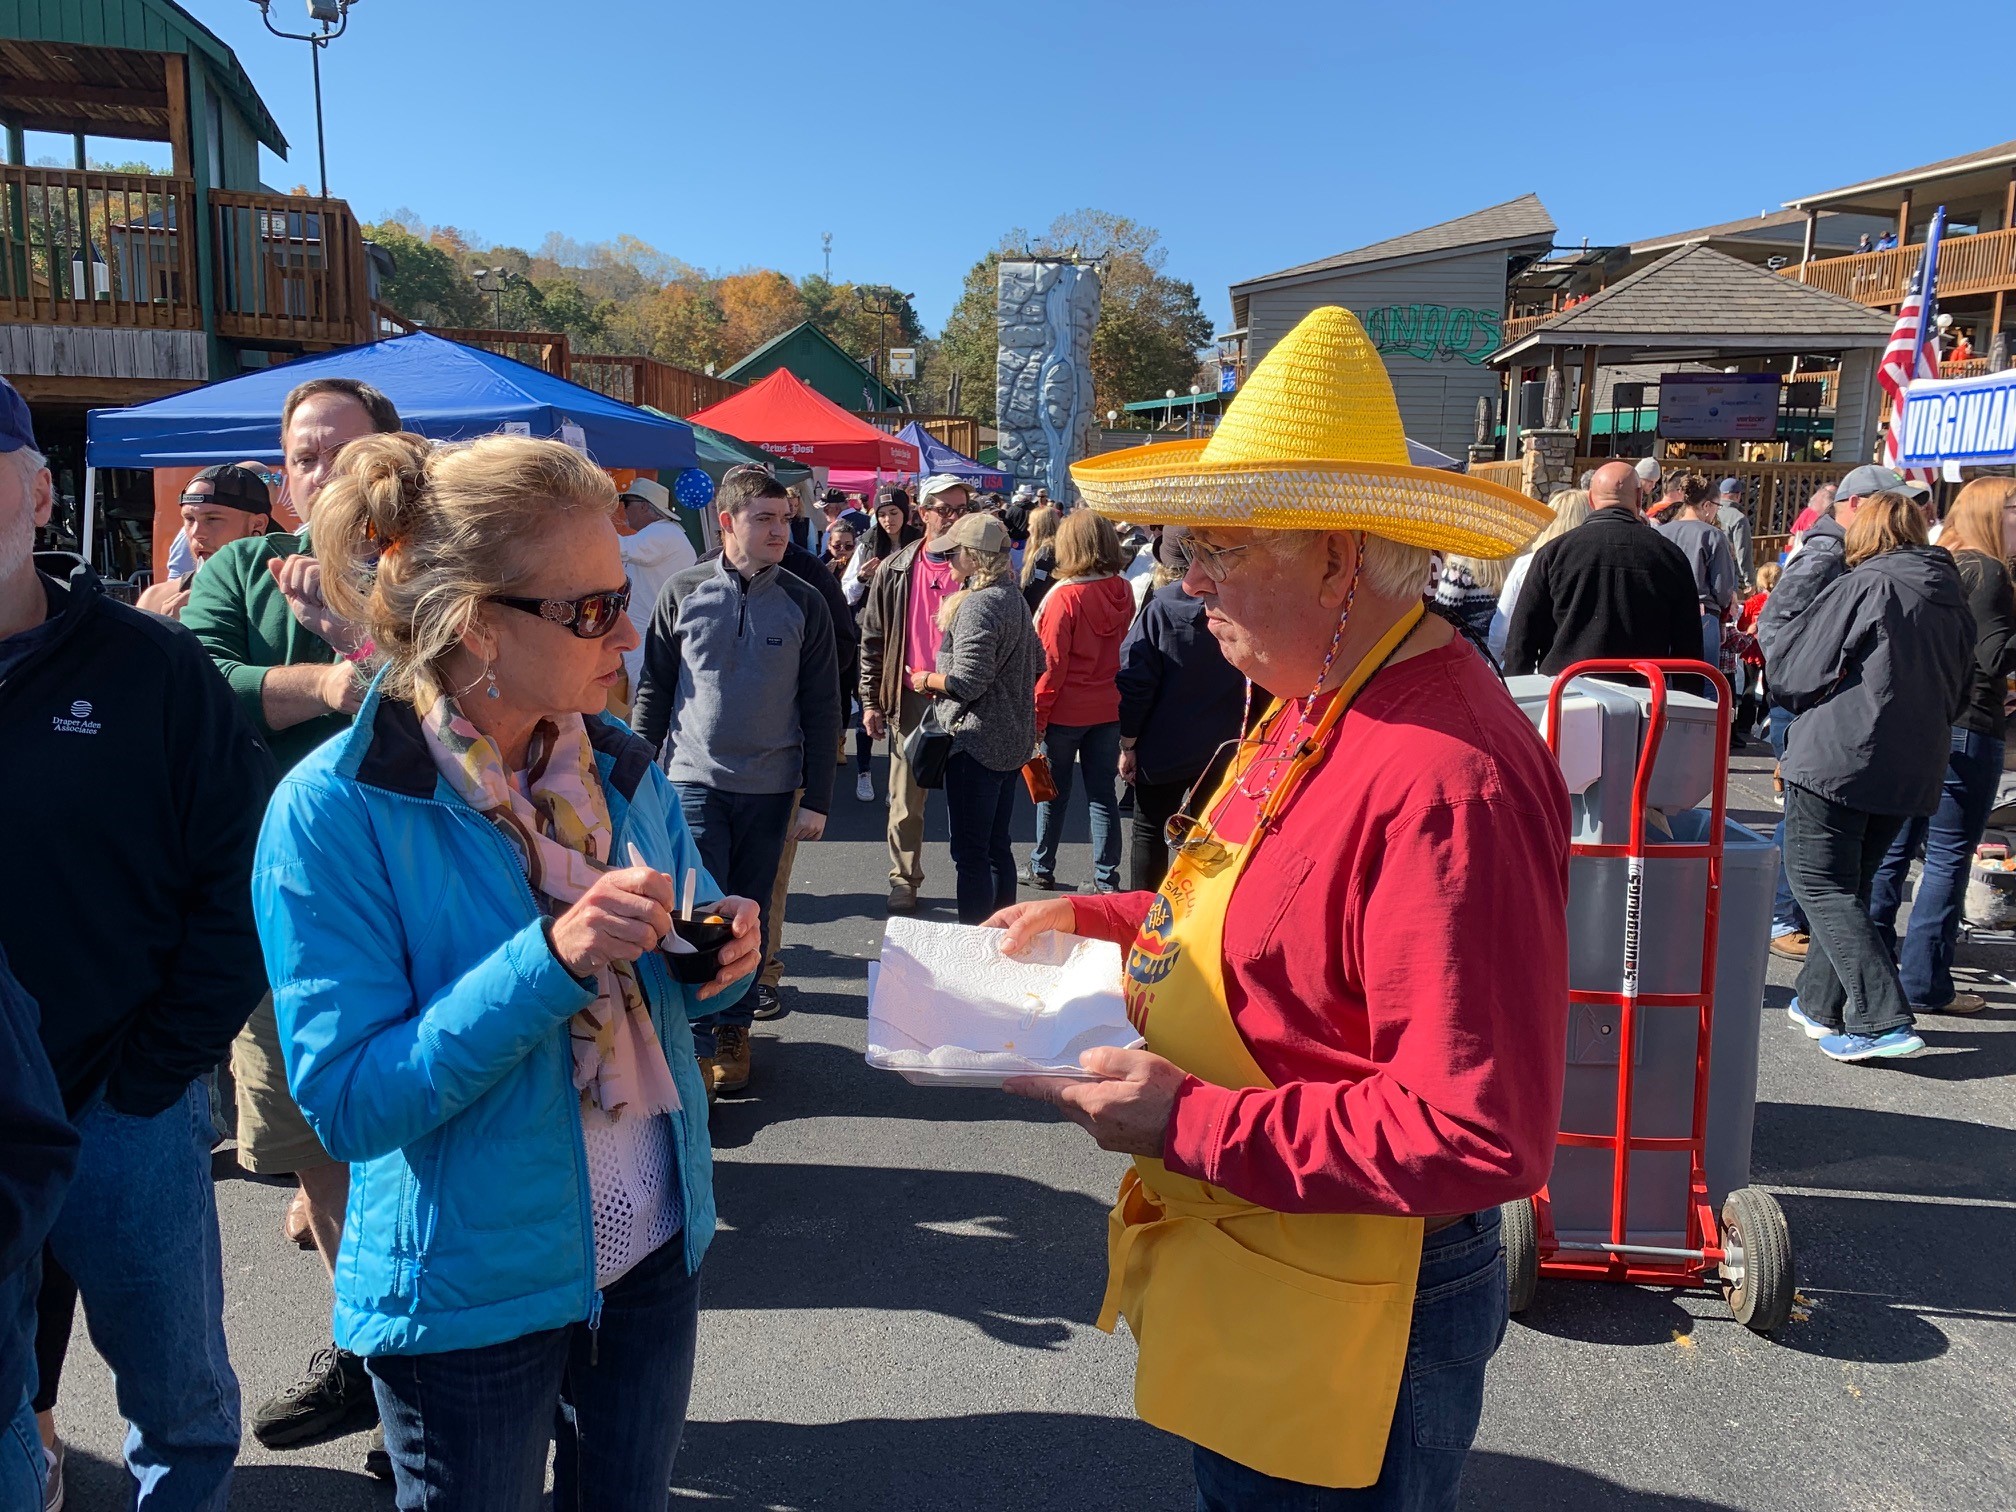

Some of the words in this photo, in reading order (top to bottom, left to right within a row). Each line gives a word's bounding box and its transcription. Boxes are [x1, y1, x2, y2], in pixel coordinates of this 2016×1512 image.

[1355, 303, 1503, 365] ANDOS
[983, 476, 1004, 489] USA
[52, 716, 80, 726] Draper
[53, 724, 98, 735] Associates
[1164, 880, 1184, 906] SML
[1149, 897, 1164, 916] ed
[1148, 908, 1170, 930] Hot
